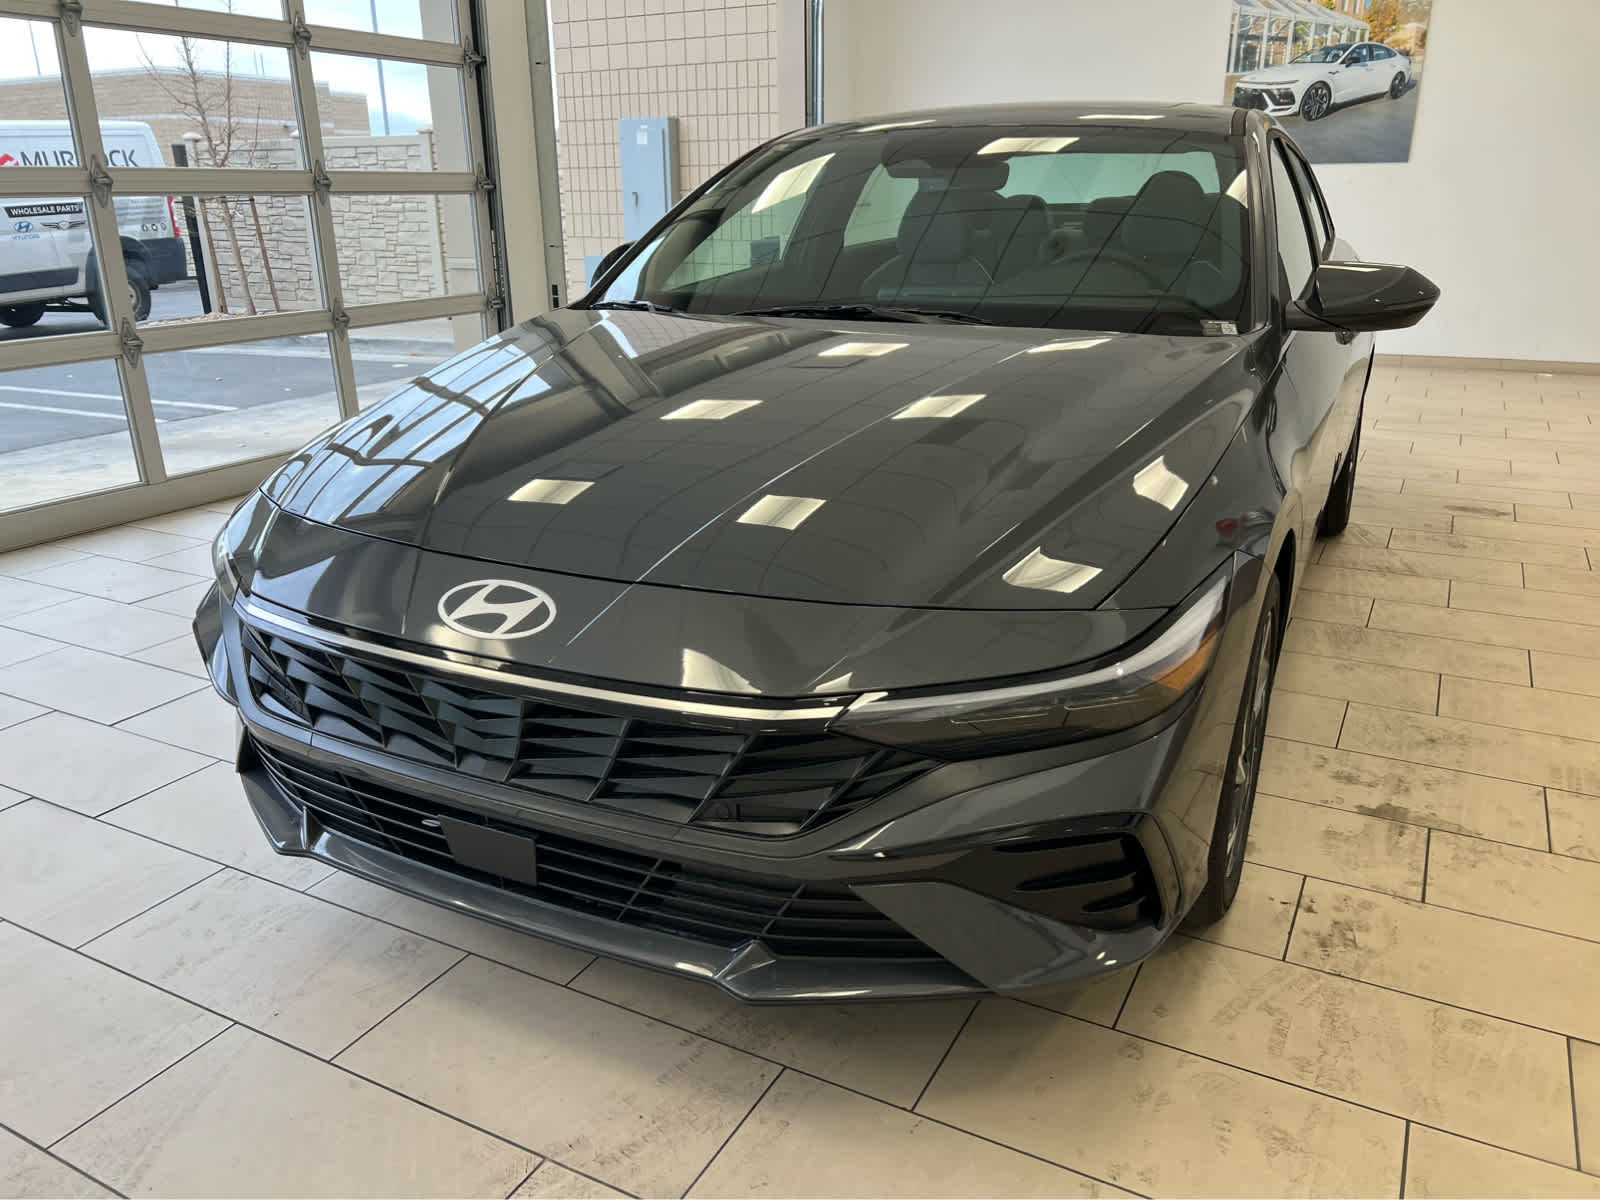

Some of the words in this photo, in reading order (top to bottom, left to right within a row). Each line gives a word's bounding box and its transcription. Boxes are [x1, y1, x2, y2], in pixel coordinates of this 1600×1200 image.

[20, 149, 138, 167] MURCK
[10, 206, 55, 215] WHOLESALE
[56, 204, 80, 214] PARTS
